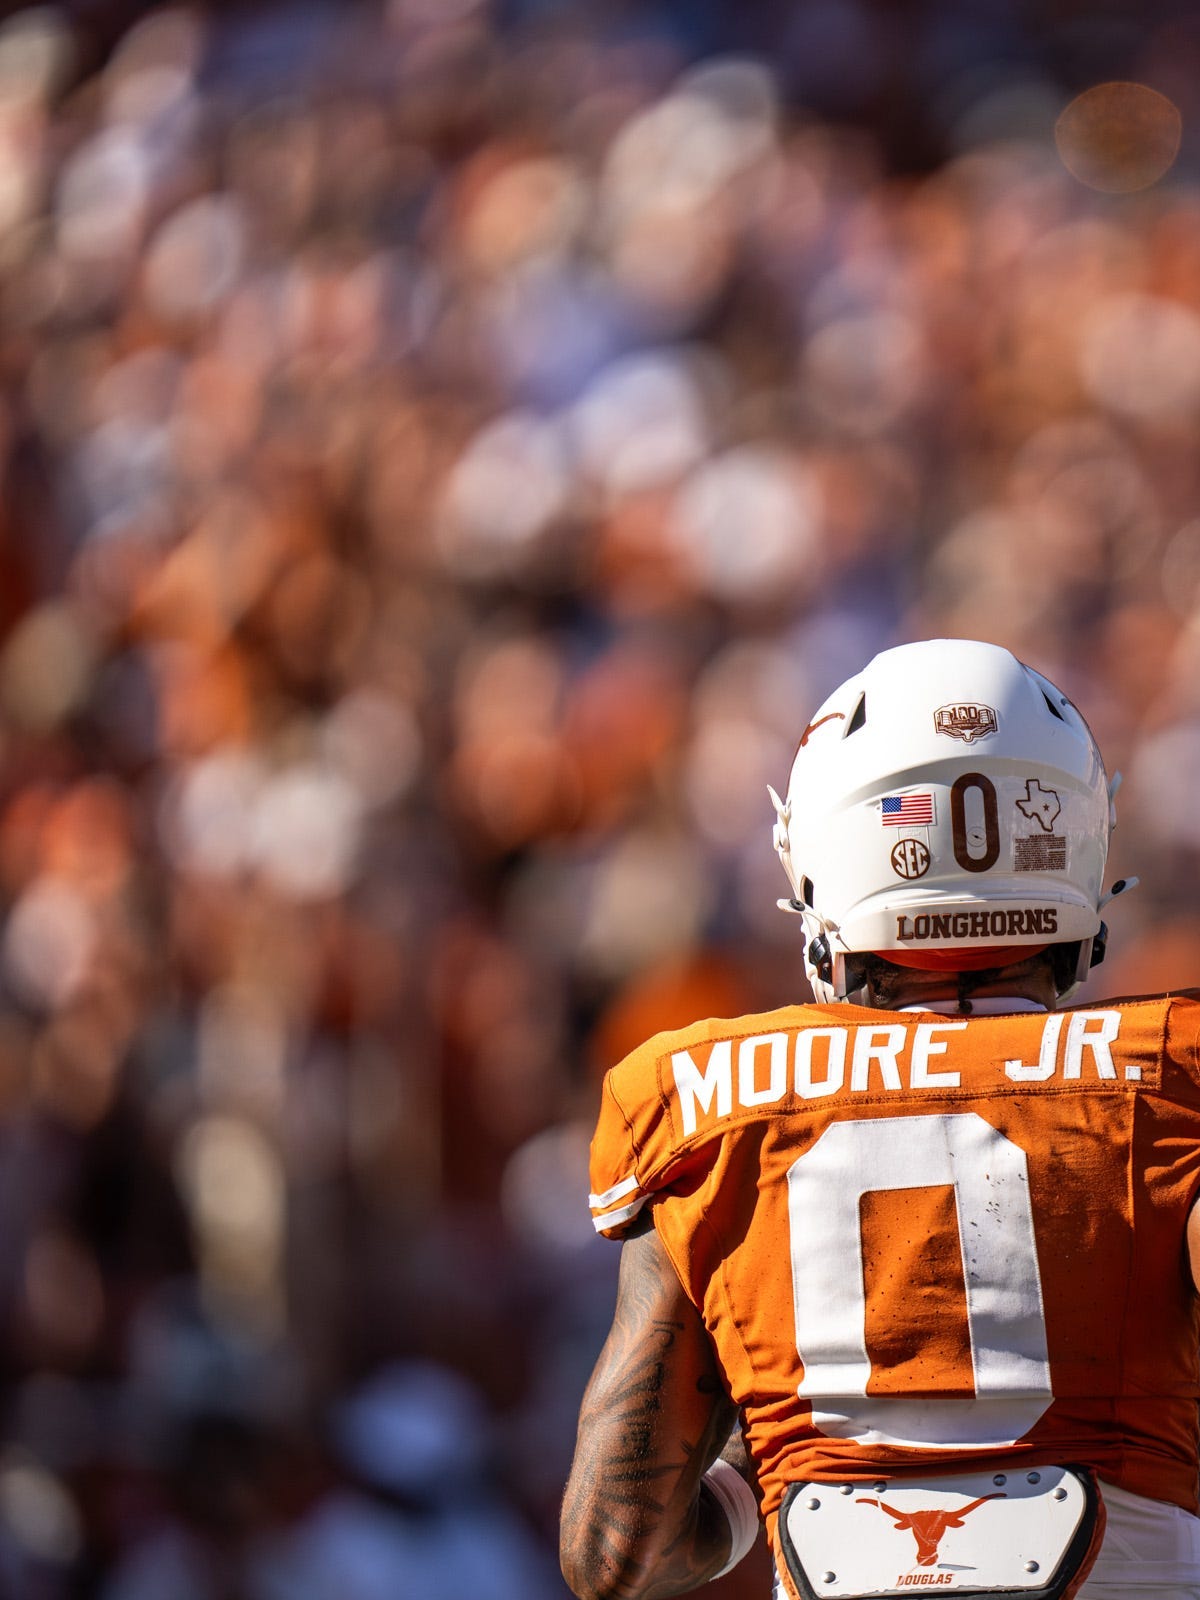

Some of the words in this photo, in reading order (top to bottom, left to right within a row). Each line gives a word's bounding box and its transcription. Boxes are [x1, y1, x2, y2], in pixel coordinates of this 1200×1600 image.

[952, 706, 977, 720] 100
[950, 772, 1000, 873] 0
[892, 840, 930, 878] SEC
[897, 909, 1058, 941] LONGHORNS
[671, 1022, 968, 1137] MOORE
[1005, 1010, 1142, 1082] JR.
[787, 1112, 1054, 1449] 0
[896, 1573, 955, 1586] DOUGLAS
